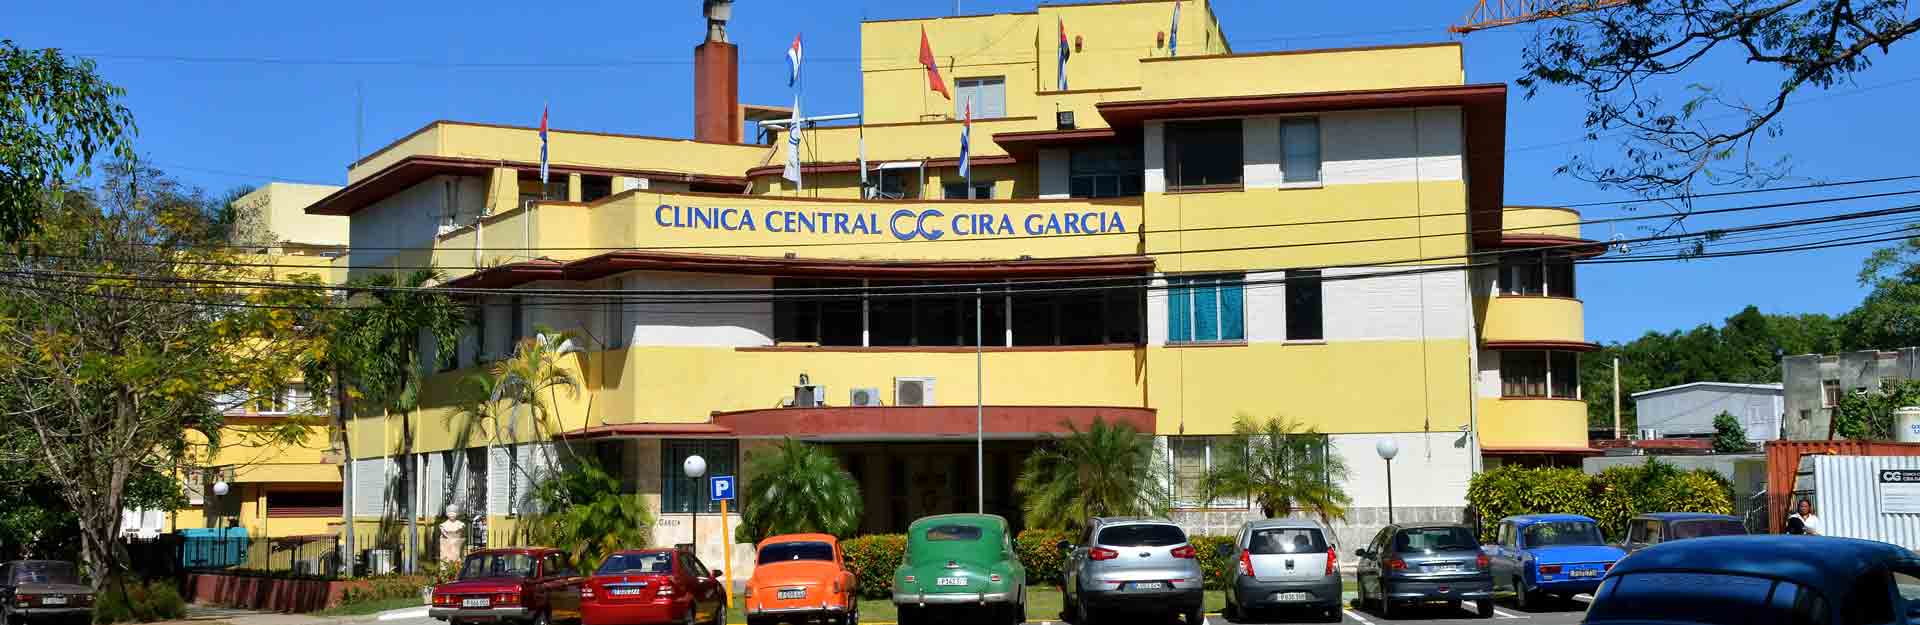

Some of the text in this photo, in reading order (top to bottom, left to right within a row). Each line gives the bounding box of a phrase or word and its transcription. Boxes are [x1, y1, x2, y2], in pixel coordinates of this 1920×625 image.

[655, 204, 756, 231] CLINICA
[765, 210, 882, 235] CENTRAL
[951, 213, 1015, 235] CIRA
[1024, 211, 1126, 235] GARCIA
[1883, 471, 1901, 480] CG
[715, 480, 729, 496] P
